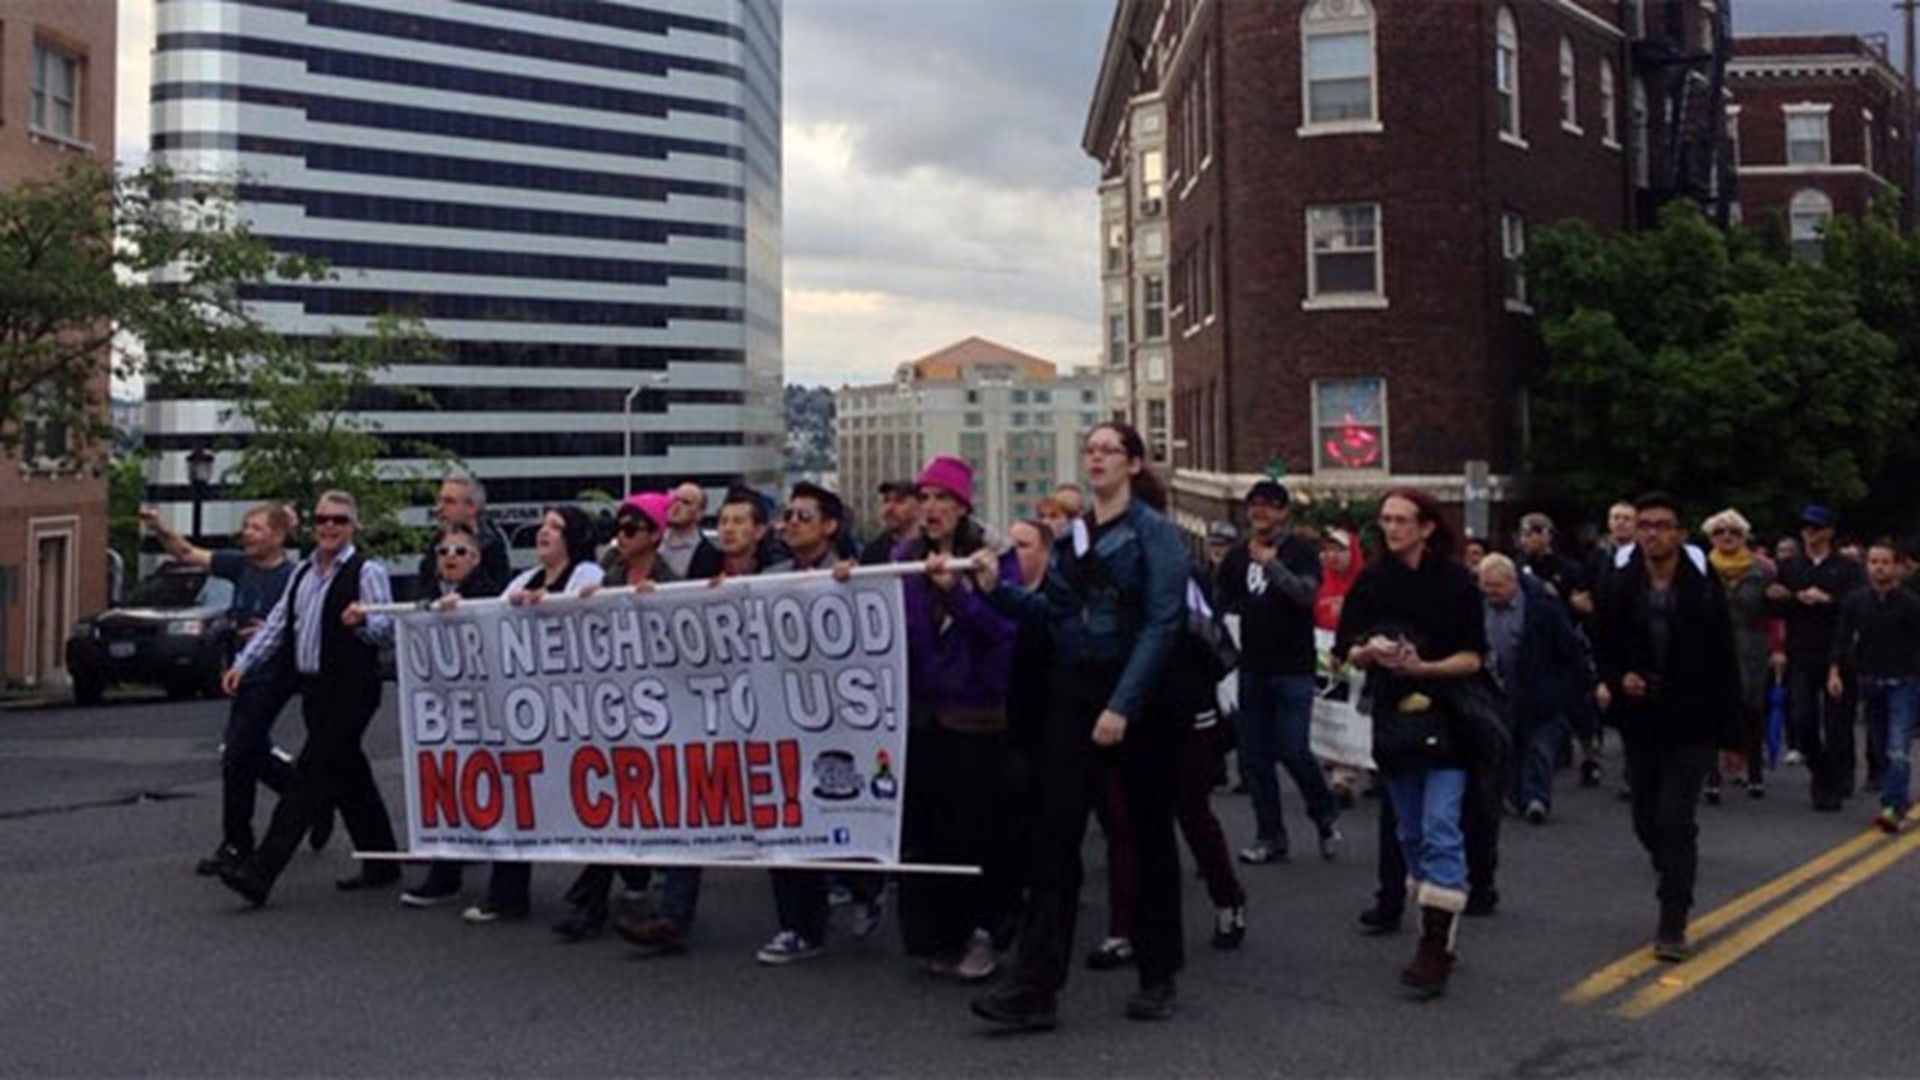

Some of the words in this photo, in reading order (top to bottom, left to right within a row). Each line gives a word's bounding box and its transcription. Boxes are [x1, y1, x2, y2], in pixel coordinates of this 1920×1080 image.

[407, 621, 489, 681] OUR
[499, 591, 896, 677] NEIGHBORHOOD
[412, 678, 671, 746] BELONGS
[688, 674, 758, 734] TO
[783, 667, 898, 733] US!
[417, 749, 544, 830] NOT
[569, 738, 802, 830] CRIME!
